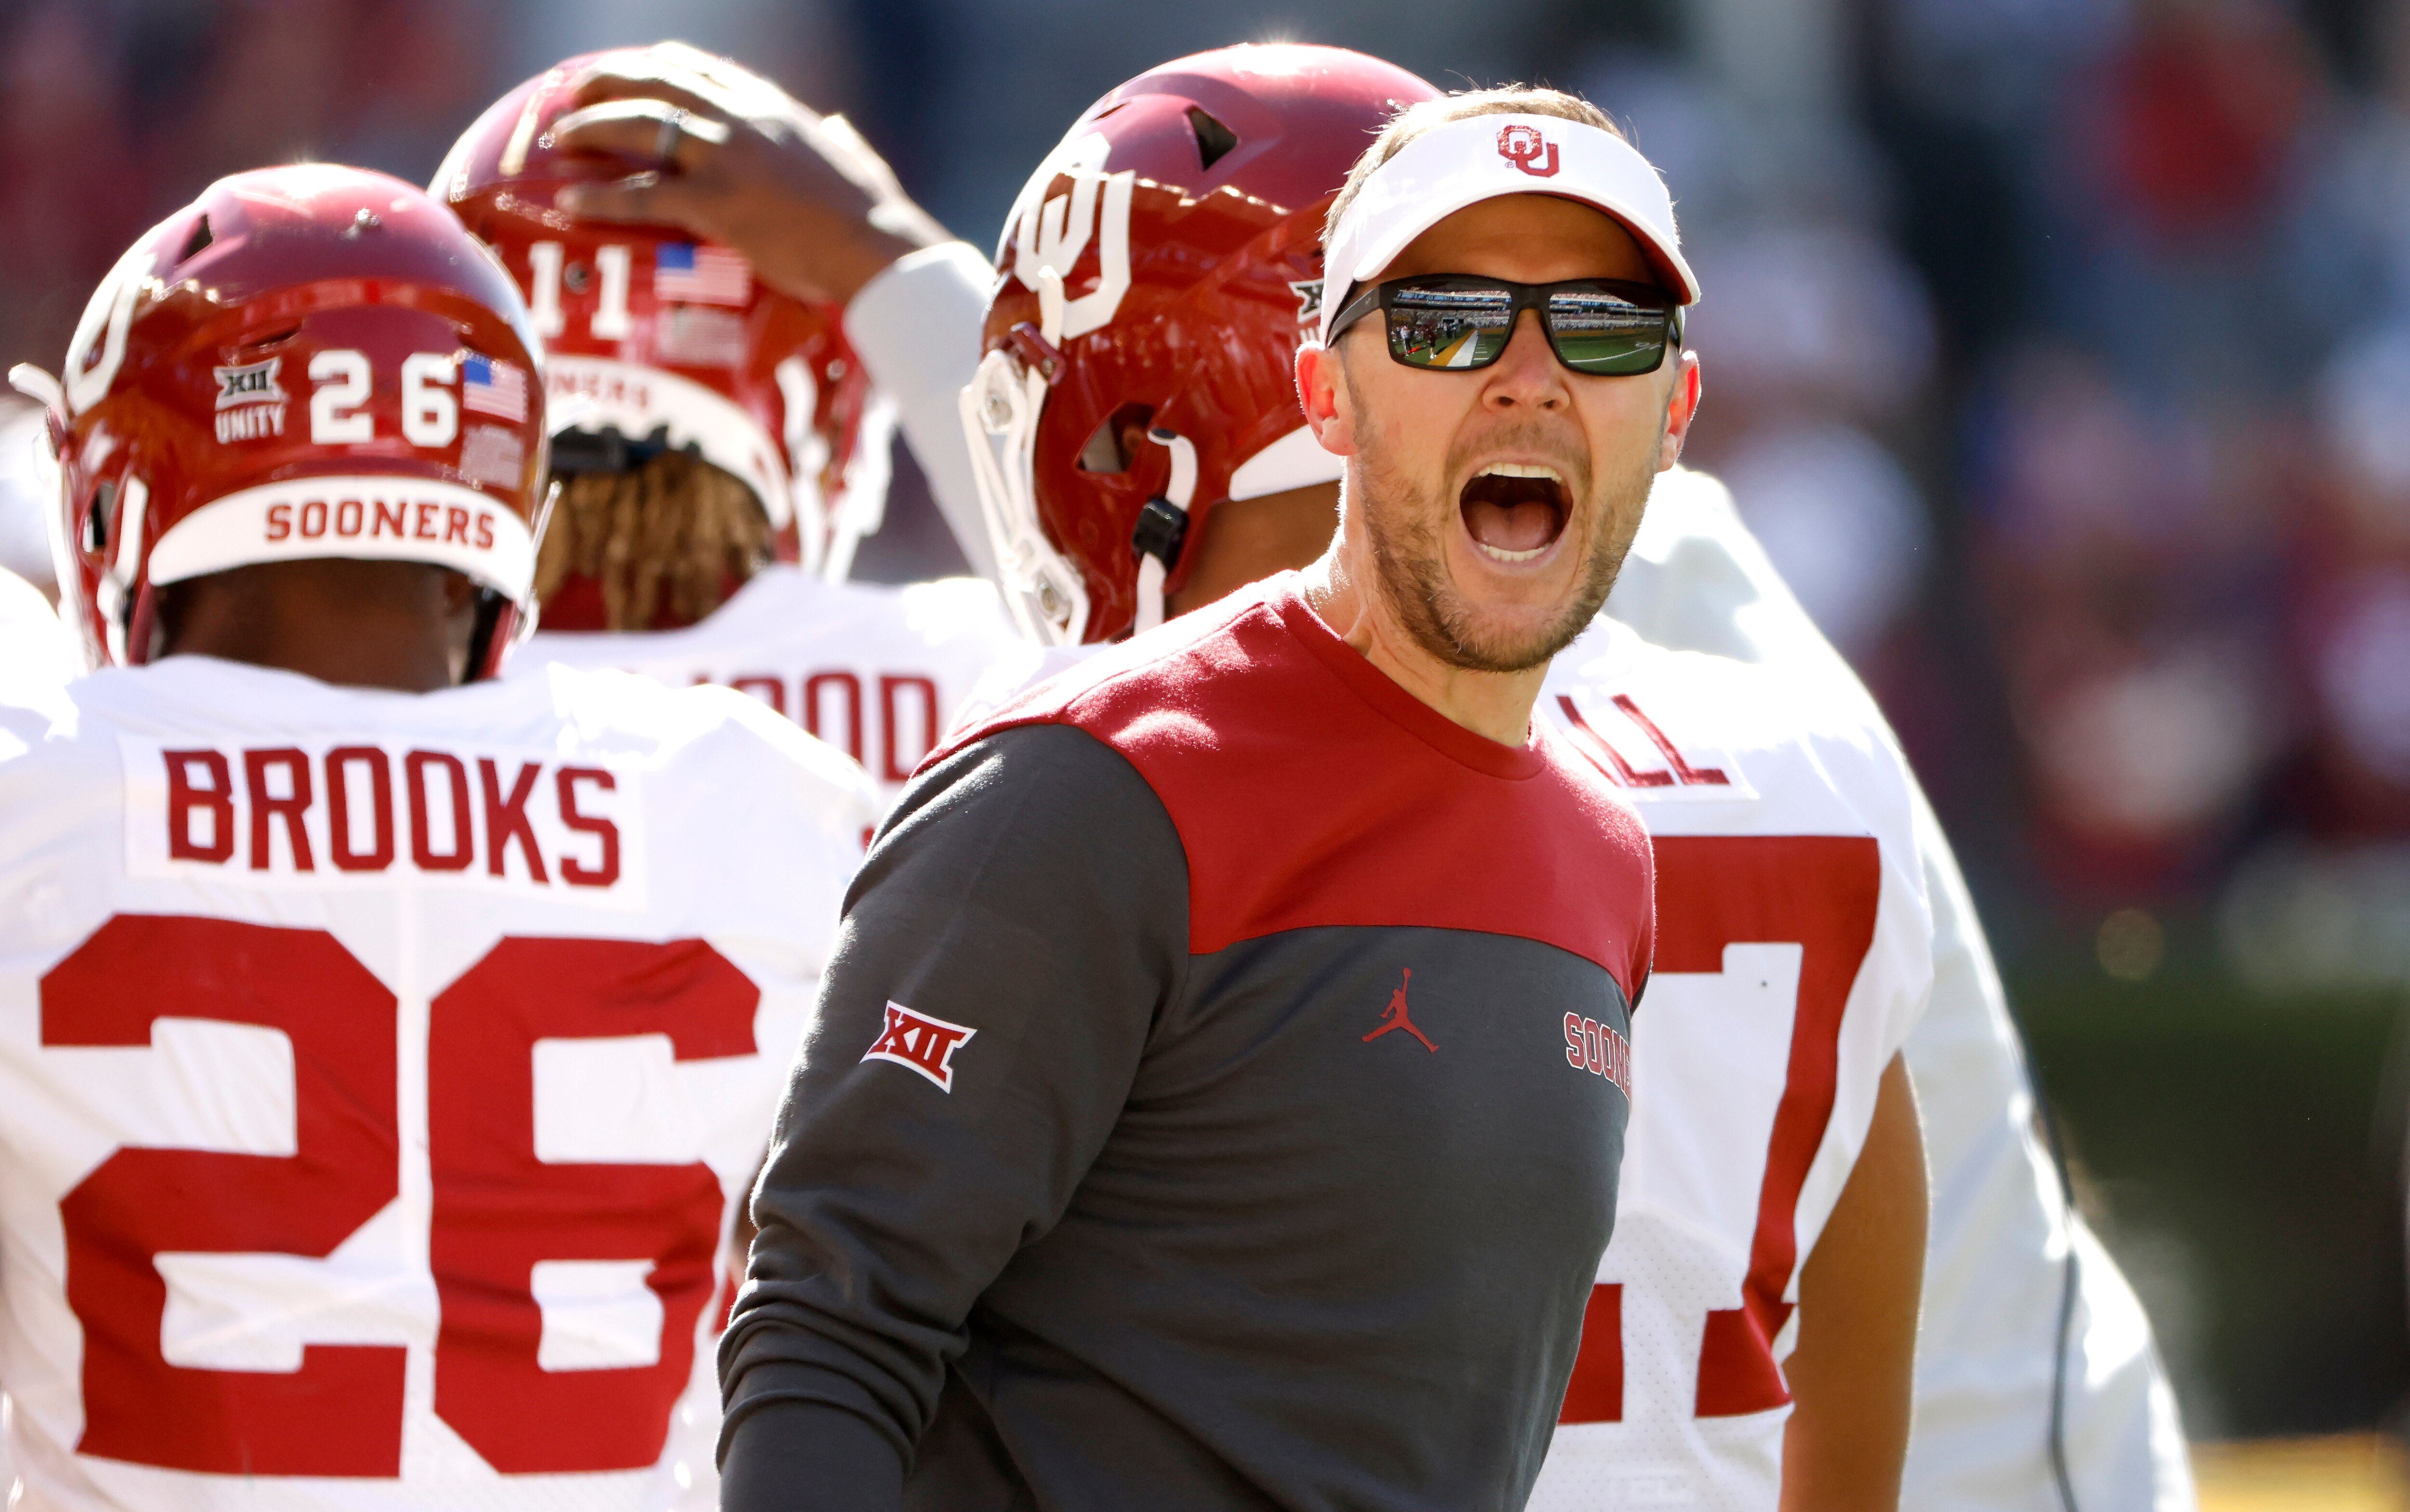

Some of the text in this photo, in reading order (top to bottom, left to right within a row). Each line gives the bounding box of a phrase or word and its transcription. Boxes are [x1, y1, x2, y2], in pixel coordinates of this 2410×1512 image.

[1497, 125, 1560, 178] OU
[528, 241, 631, 340] 11
[215, 404, 286, 444] UNITY
[308, 349, 457, 447] 26
[544, 373, 649, 410] NERS
[265, 500, 496, 550] SOONERS
[1555, 693, 1731, 788] LL
[163, 745, 620, 888] BROOKS
[859, 999, 978, 1094] XII
[38, 913, 760, 1478] 26
